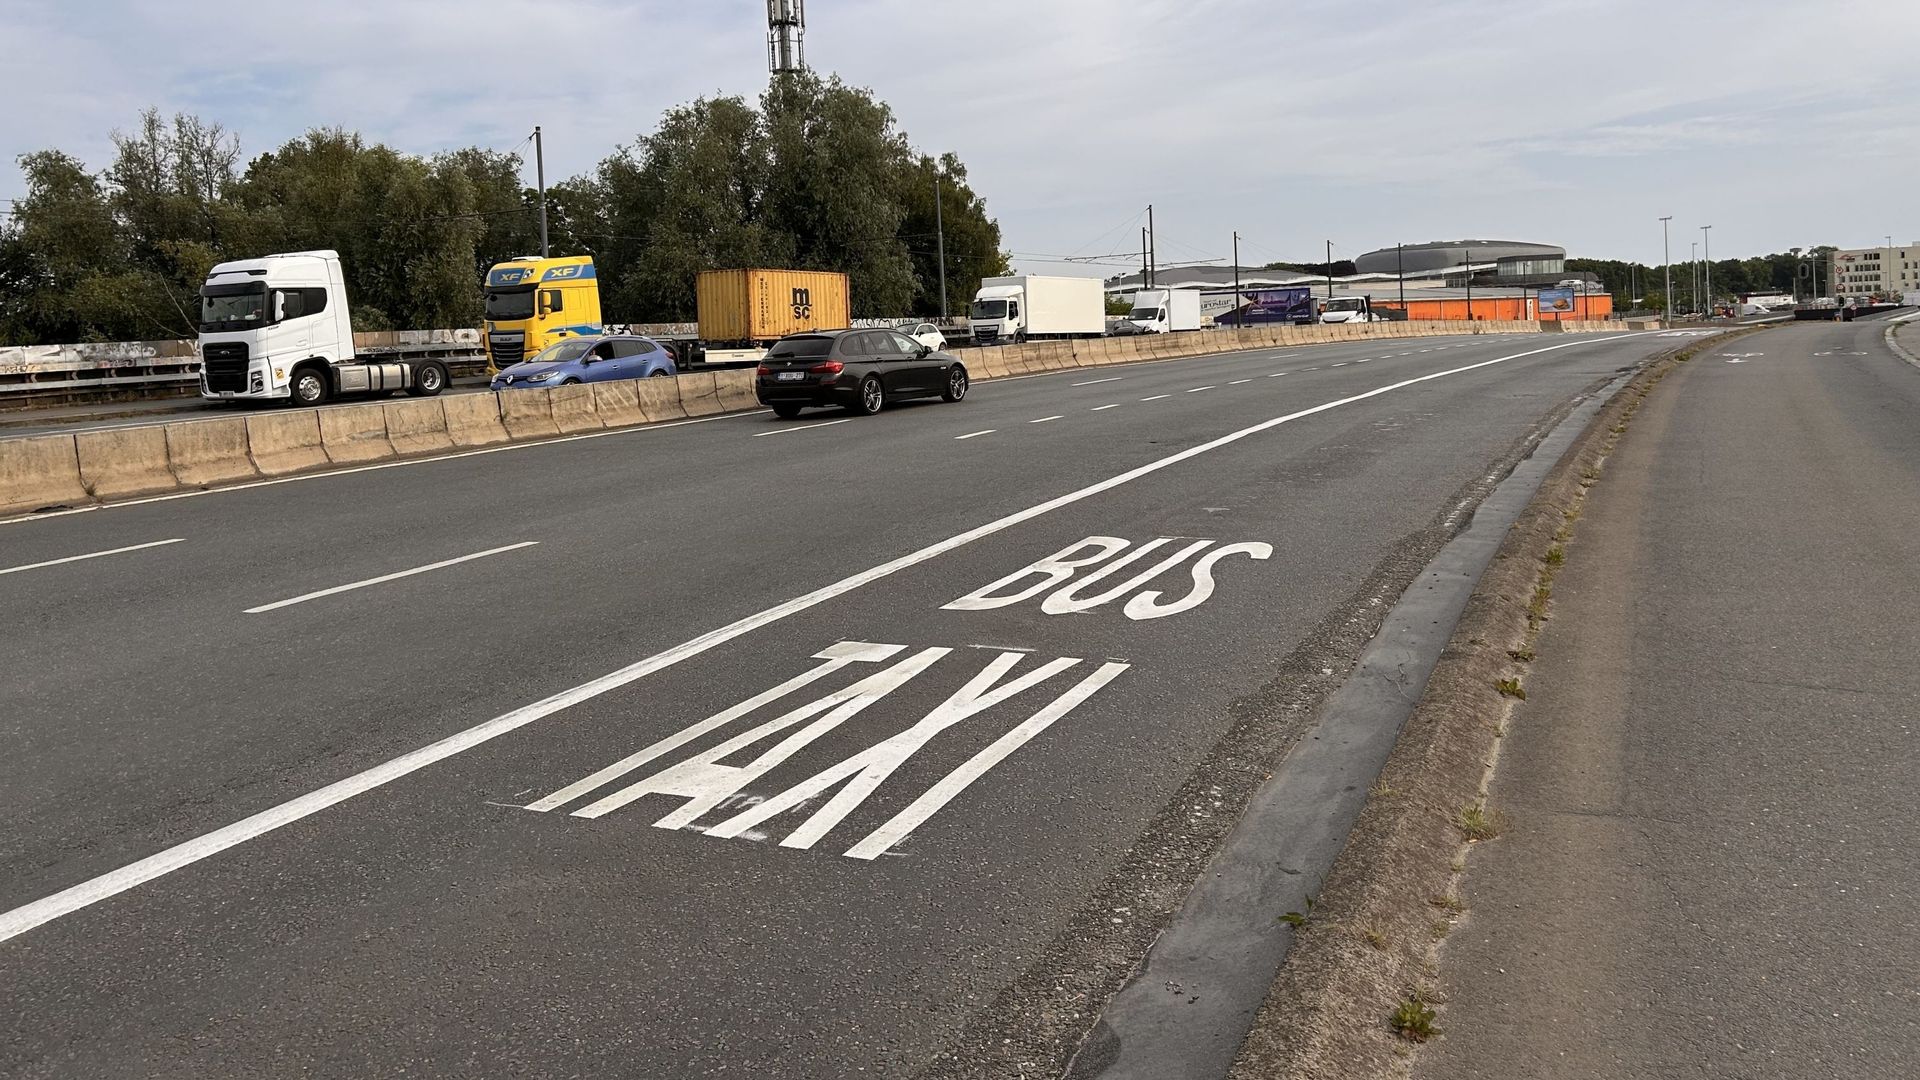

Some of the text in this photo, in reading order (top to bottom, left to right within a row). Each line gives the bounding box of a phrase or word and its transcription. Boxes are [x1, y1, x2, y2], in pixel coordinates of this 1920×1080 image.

[551, 268, 574, 277] XF
[1200, 299, 1229, 309] urostar
[939, 536, 1273, 620] BUS
[523, 641, 1130, 859] TAXI
